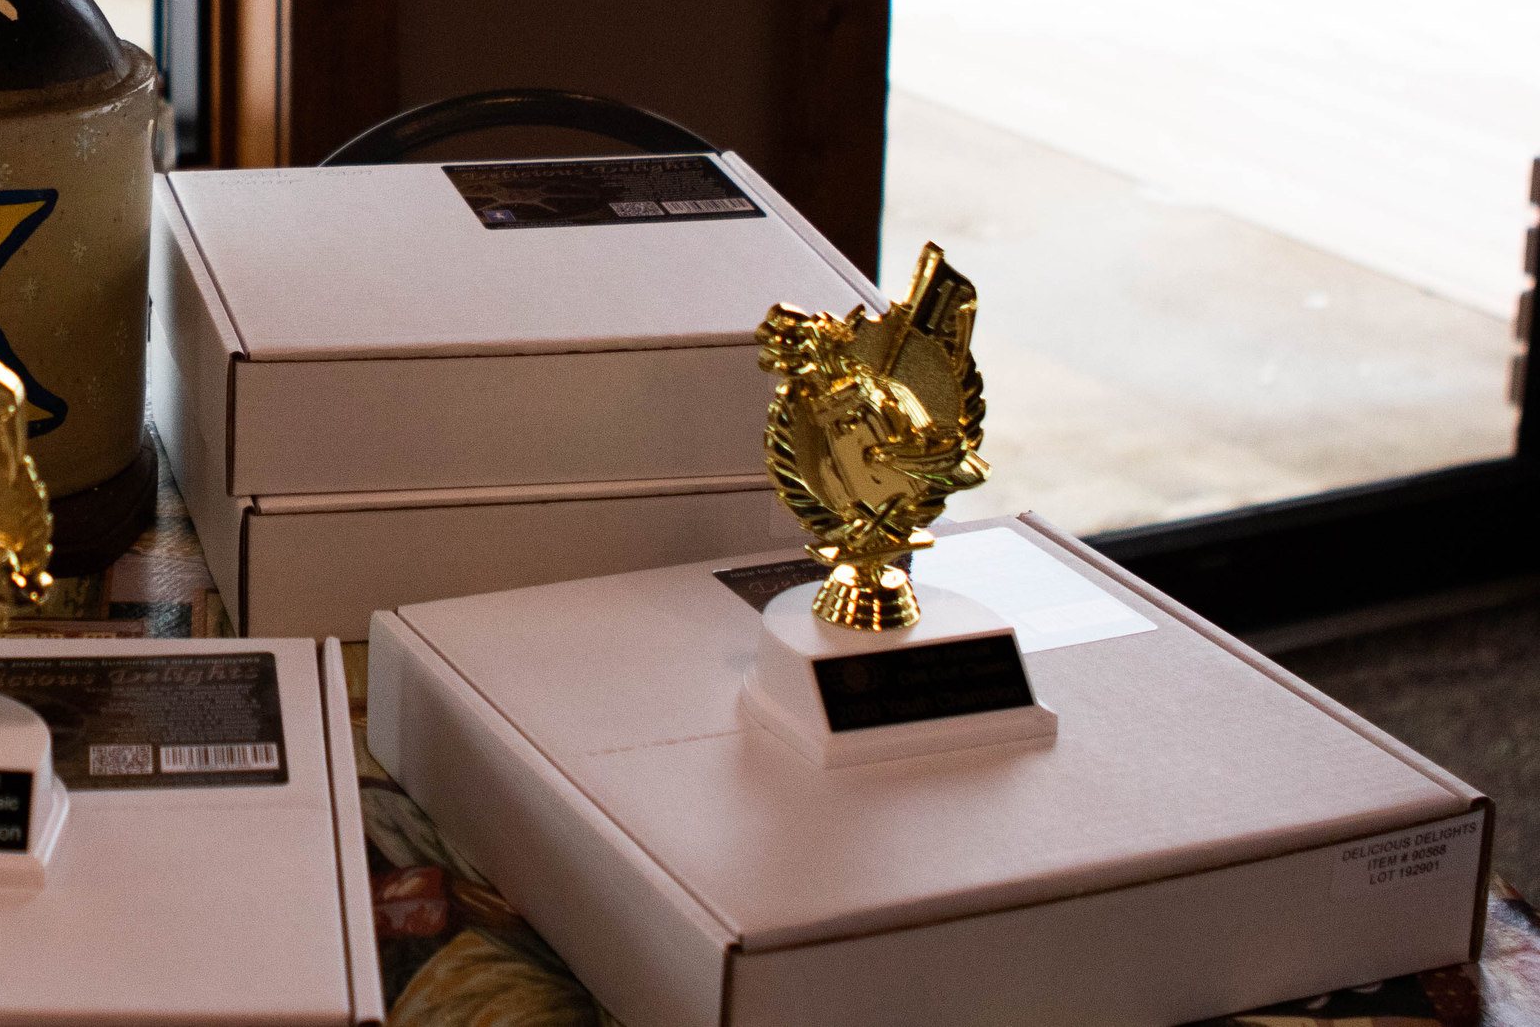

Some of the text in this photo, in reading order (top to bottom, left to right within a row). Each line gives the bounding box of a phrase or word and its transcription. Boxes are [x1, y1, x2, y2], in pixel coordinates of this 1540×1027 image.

[1342, 822, 1477, 862] DELICIOUS DELIGHTS
[1367, 855, 1398, 871] ITEM
[1369, 869, 1395, 885] LOT
